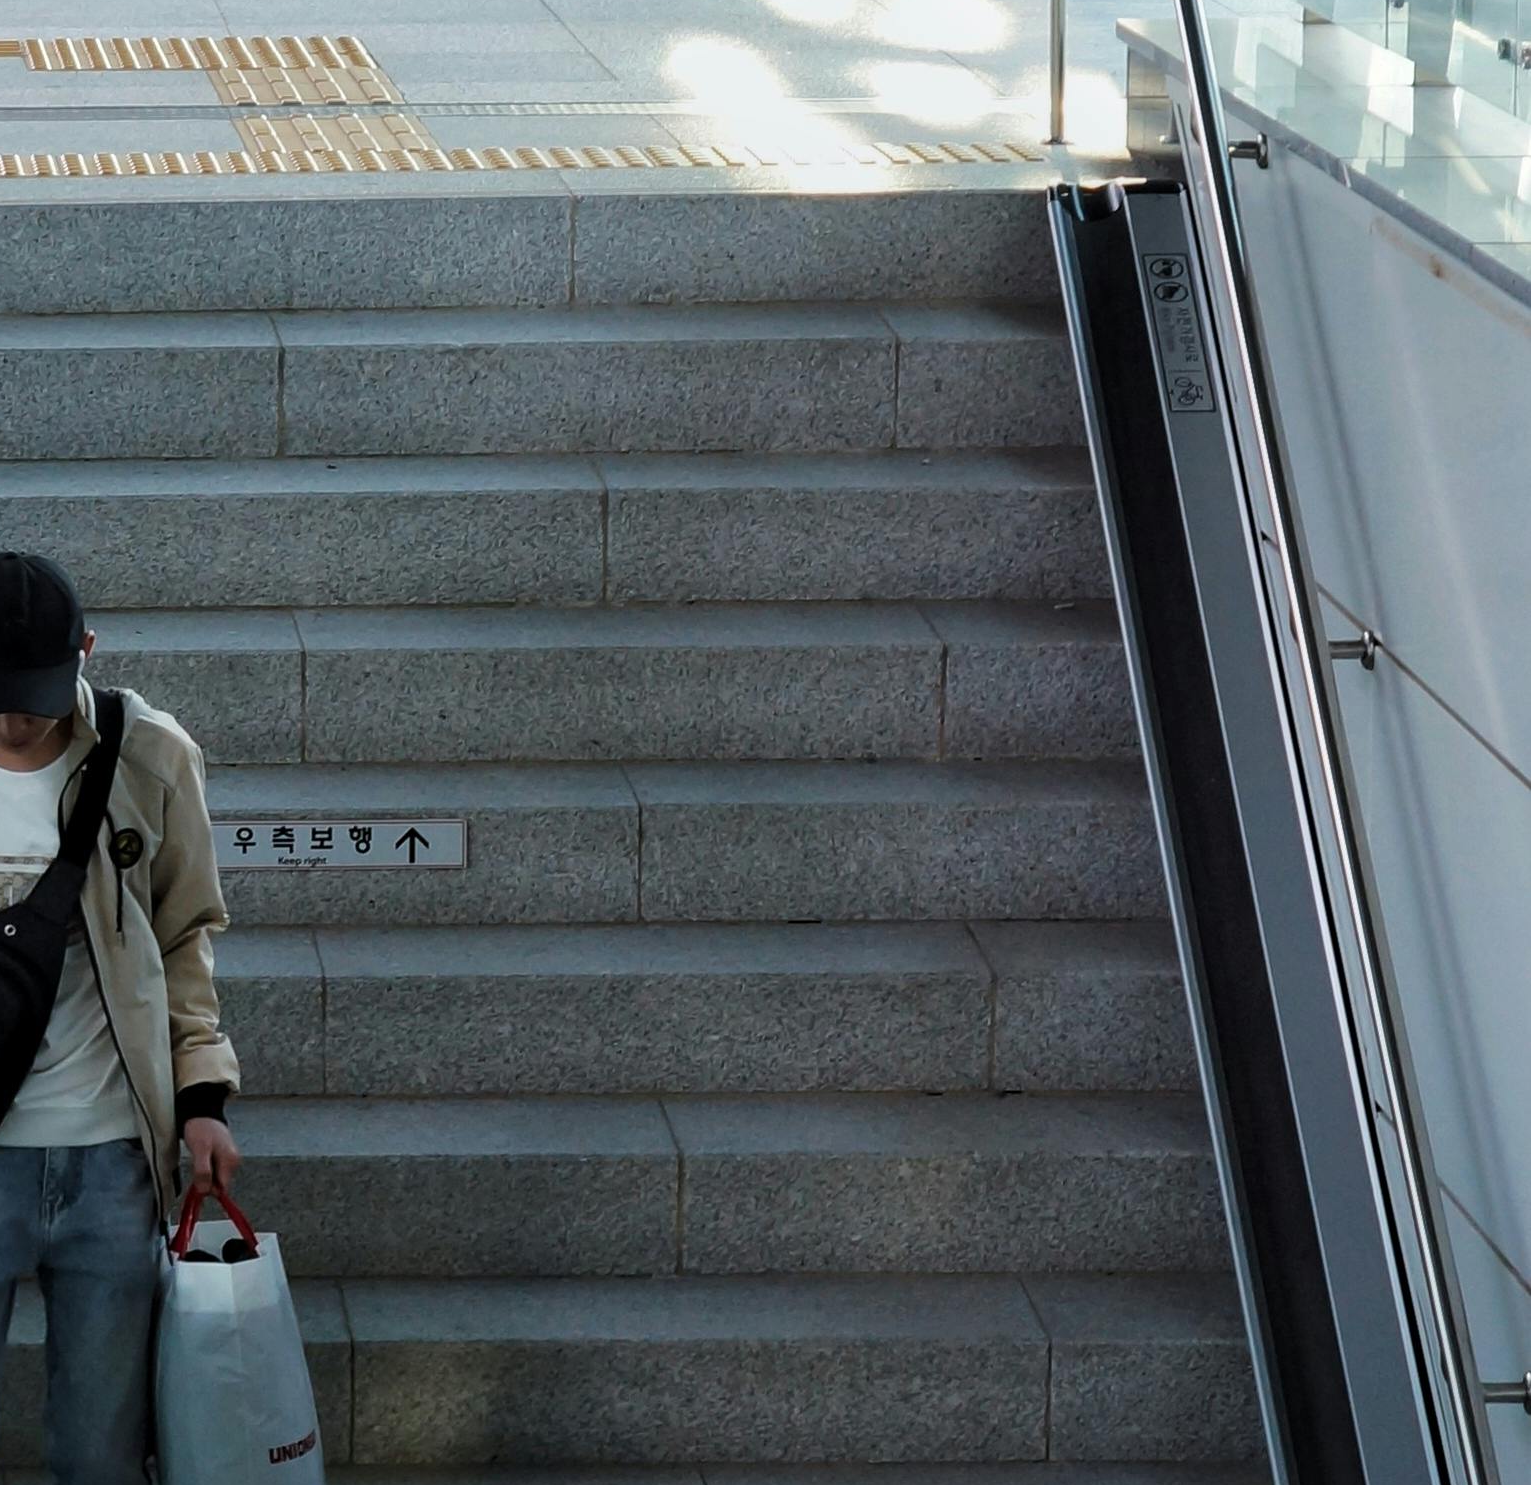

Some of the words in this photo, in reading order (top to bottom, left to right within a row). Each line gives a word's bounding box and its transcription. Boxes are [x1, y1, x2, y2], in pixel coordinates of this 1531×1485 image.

[233, 826, 373, 854] 우측보행
[277, 856, 302, 866] Keep
[303, 856, 328, 867] right
